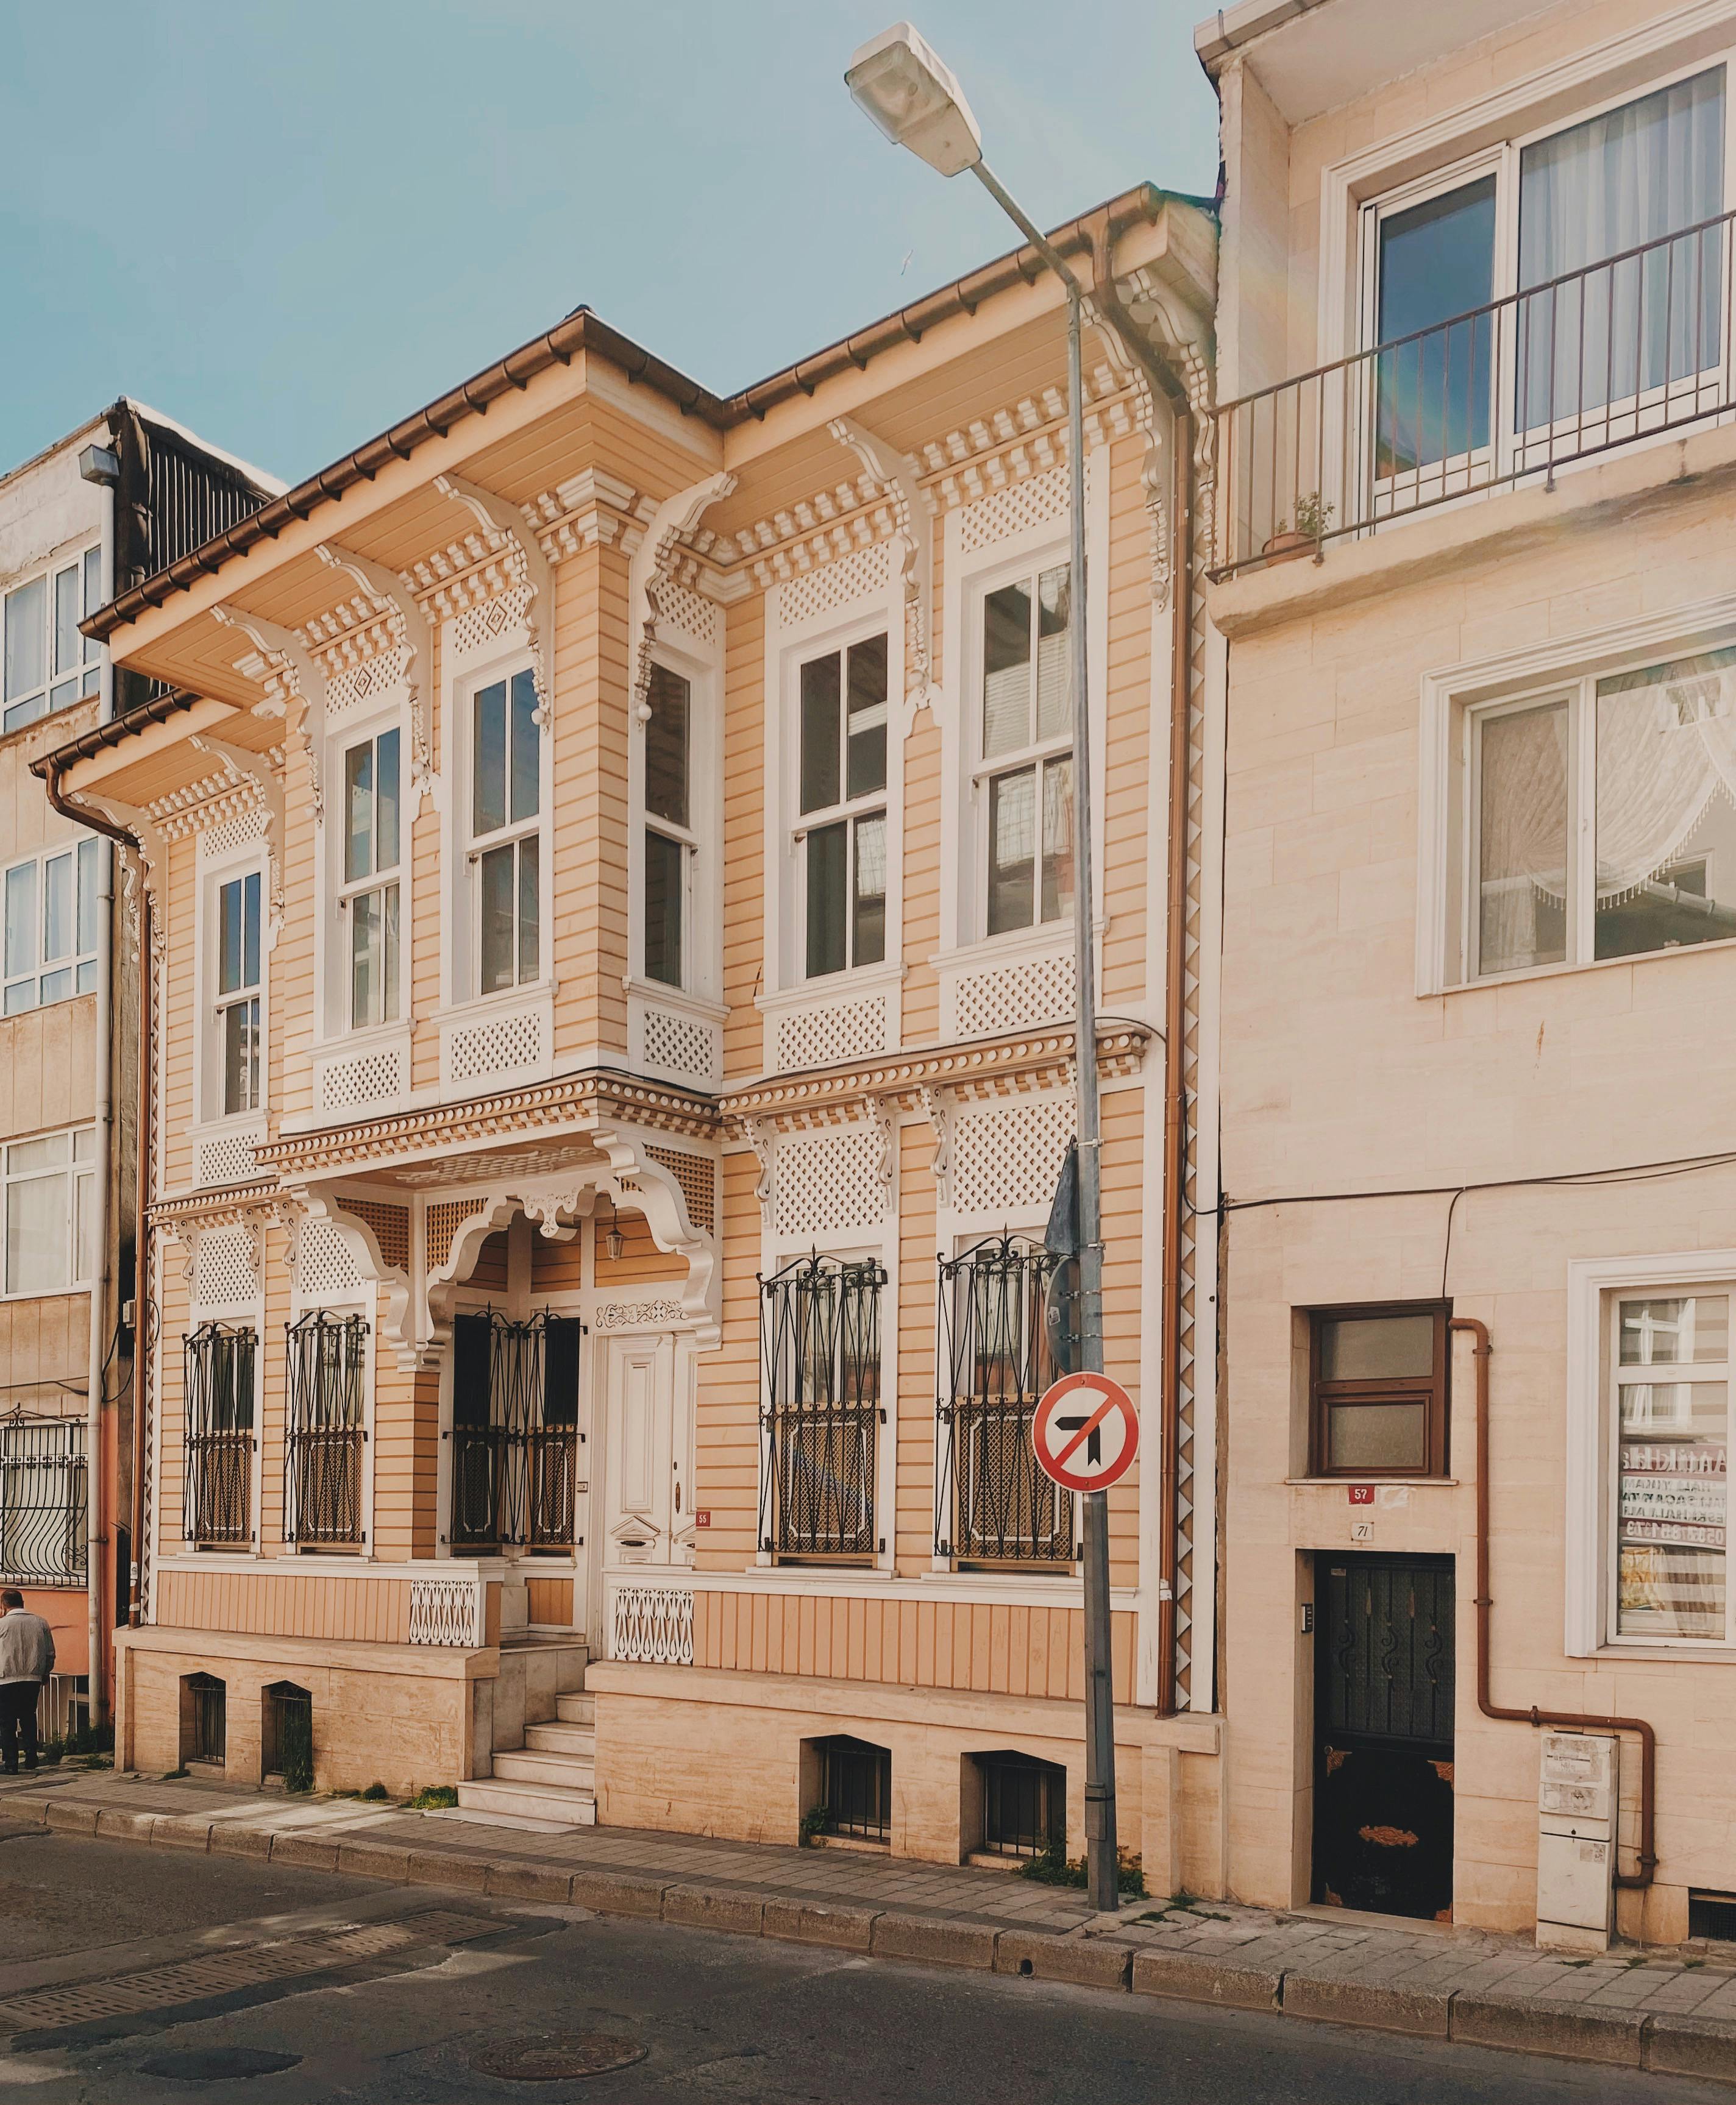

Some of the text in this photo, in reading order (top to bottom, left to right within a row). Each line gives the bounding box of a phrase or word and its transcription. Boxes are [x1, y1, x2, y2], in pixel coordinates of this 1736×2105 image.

[1354, 1488, 1367, 1500] 57
[699, 1514, 707, 1524] 55
[1357, 1525, 1368, 1536] 71
